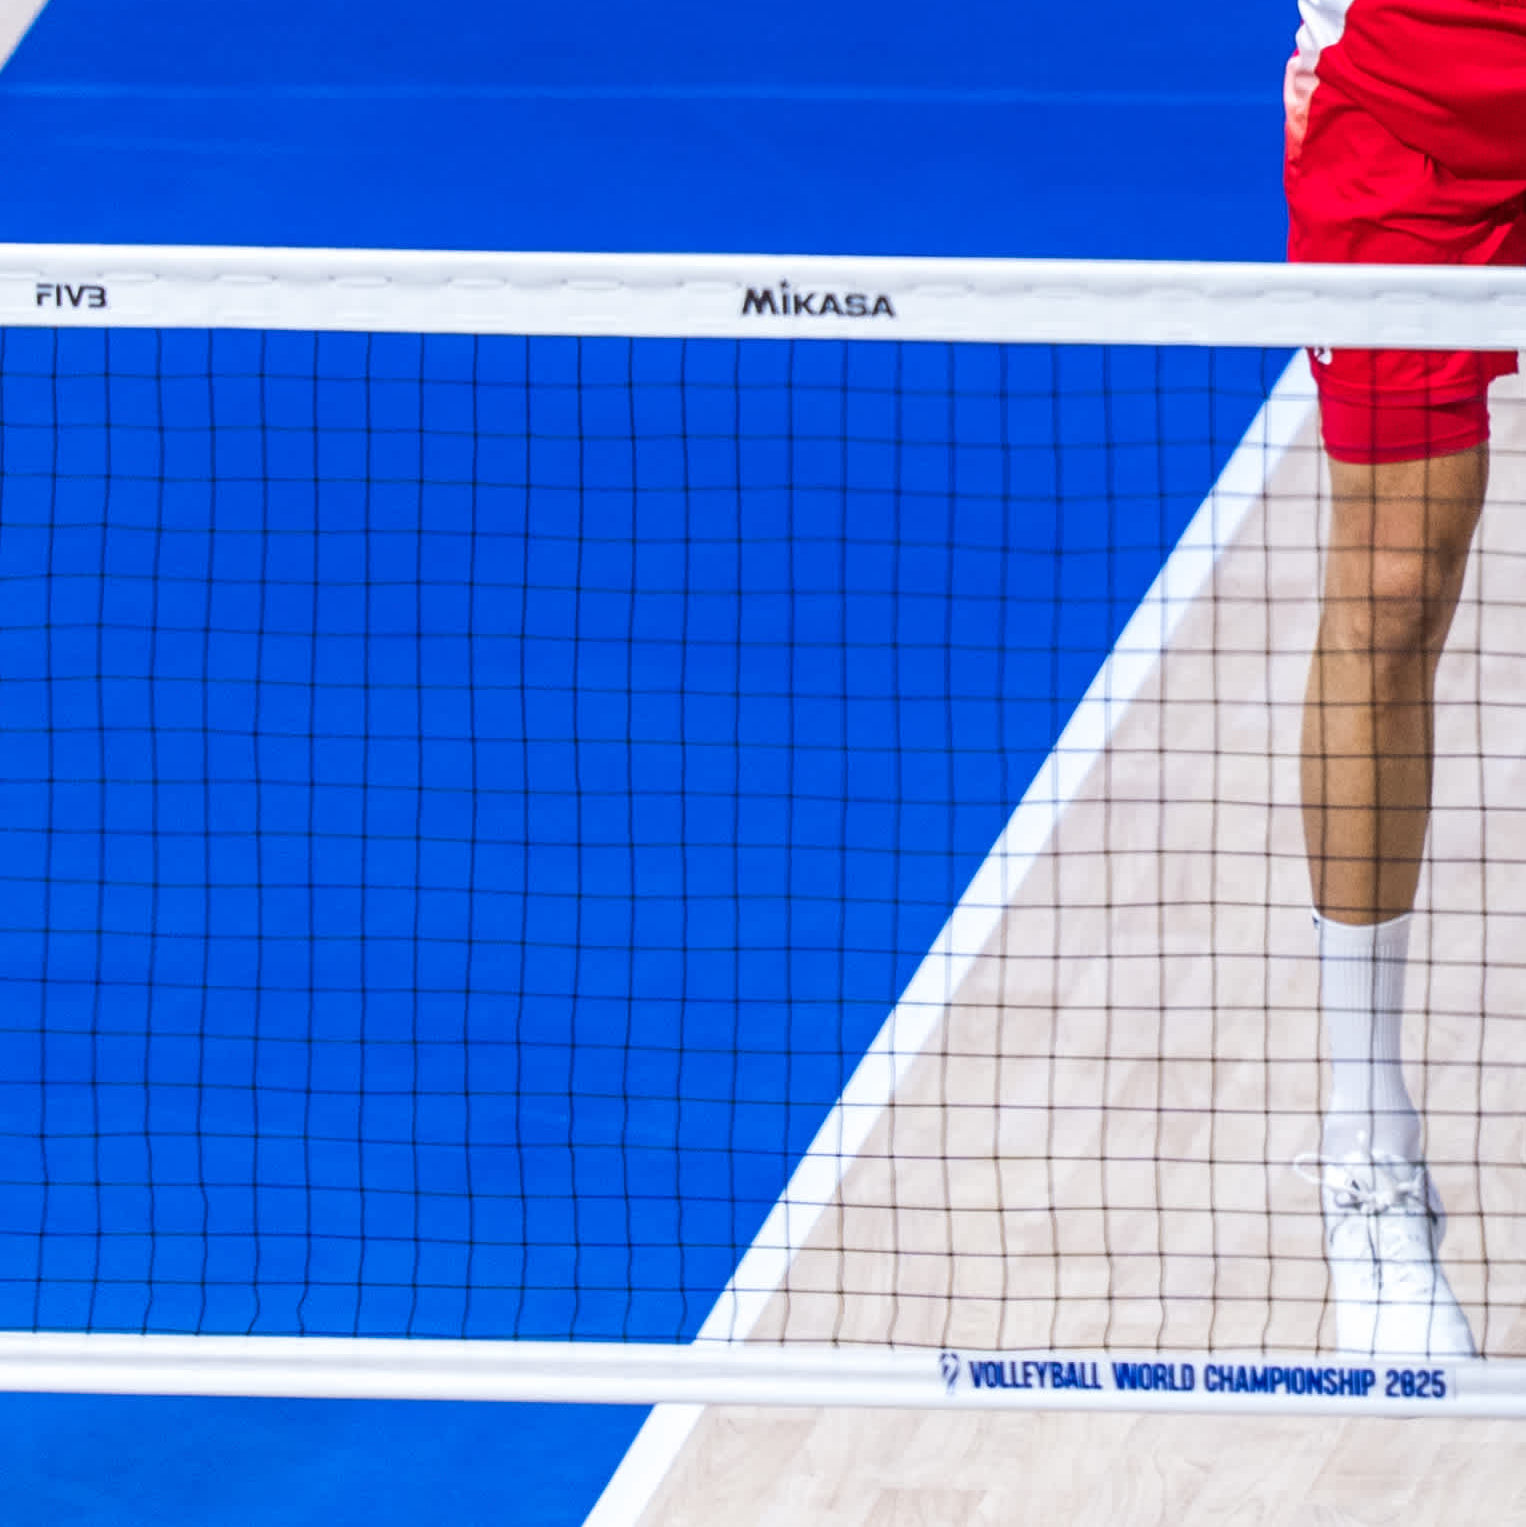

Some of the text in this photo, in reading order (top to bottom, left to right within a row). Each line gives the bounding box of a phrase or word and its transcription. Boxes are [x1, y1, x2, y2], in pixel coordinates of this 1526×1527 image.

[968, 1360, 1446, 1398] VOLLEYBALL WORLD CHAMPIONSHIP 2025
